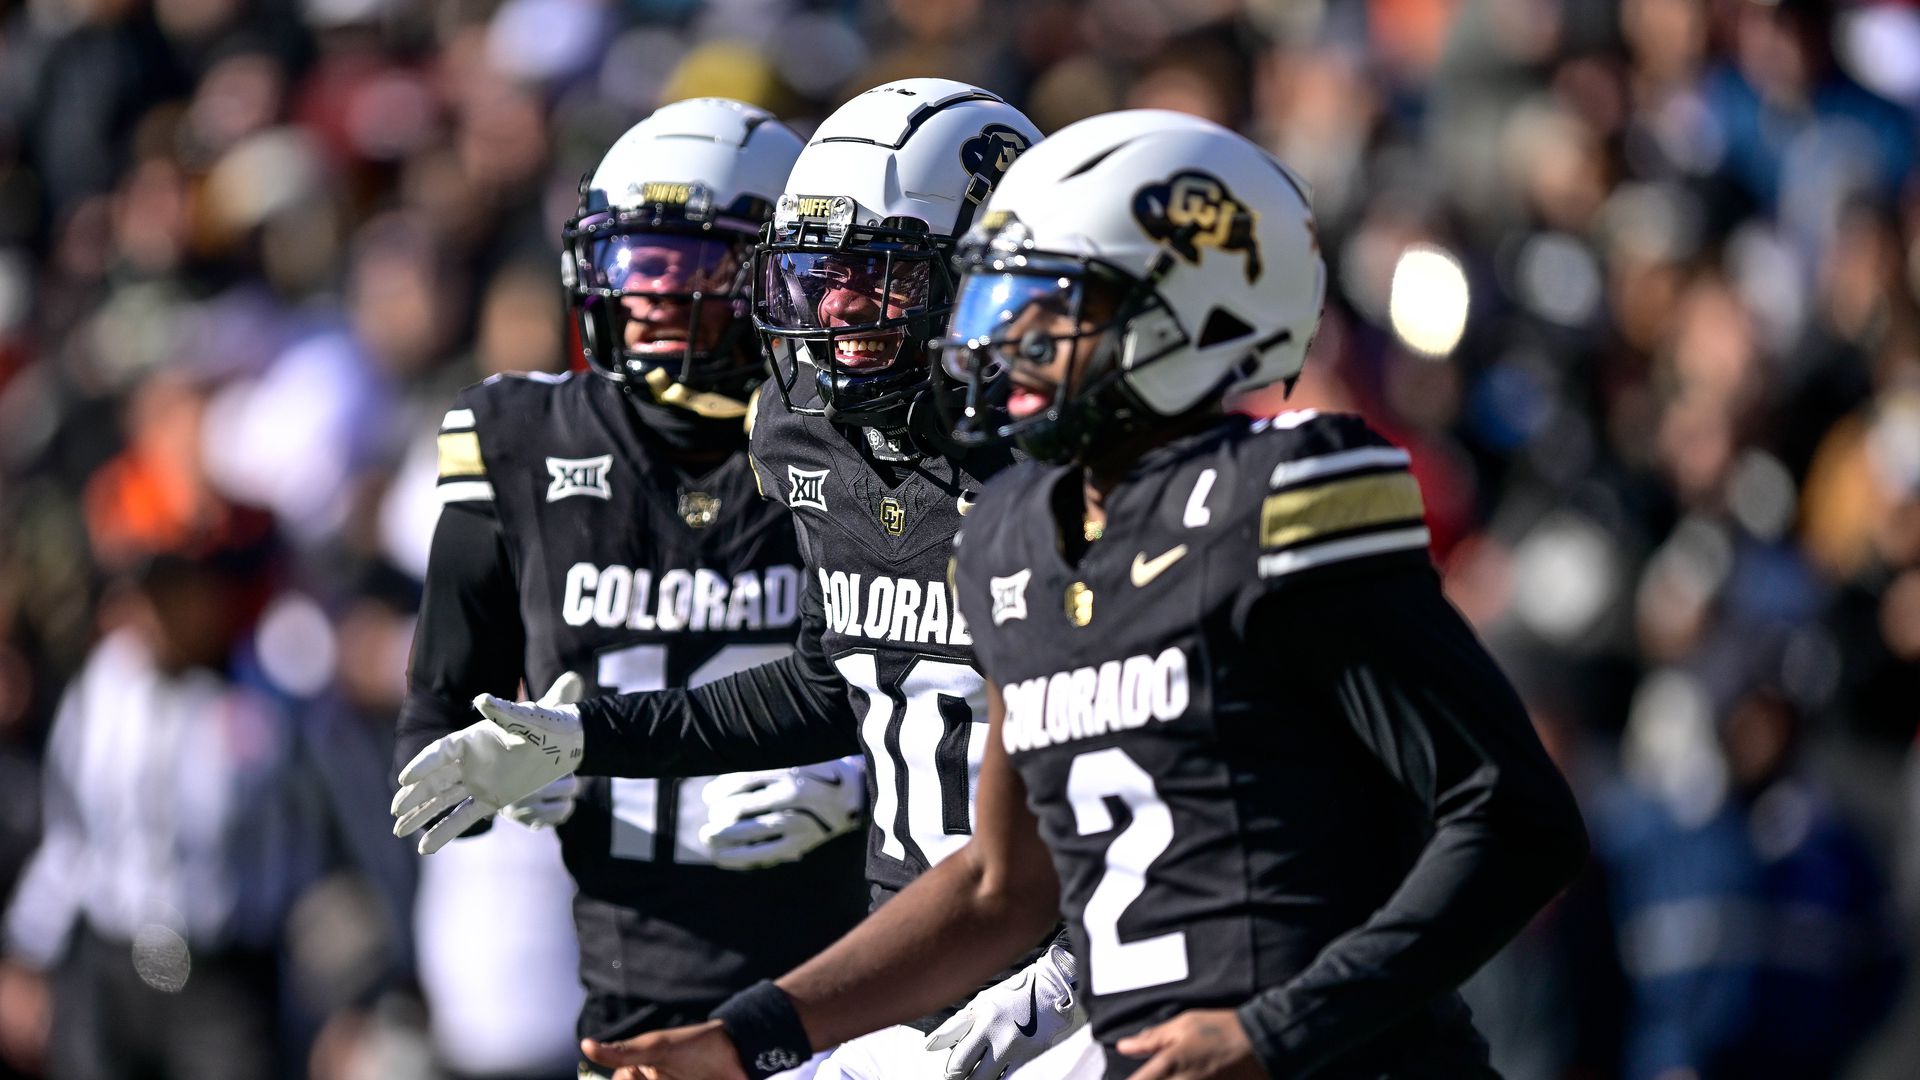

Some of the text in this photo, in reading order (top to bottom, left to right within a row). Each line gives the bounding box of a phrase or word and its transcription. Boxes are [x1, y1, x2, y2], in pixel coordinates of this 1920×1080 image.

[563, 562, 806, 632] COLORAD
[834, 652, 990, 869] 10
[1067, 746, 1189, 996] 2
